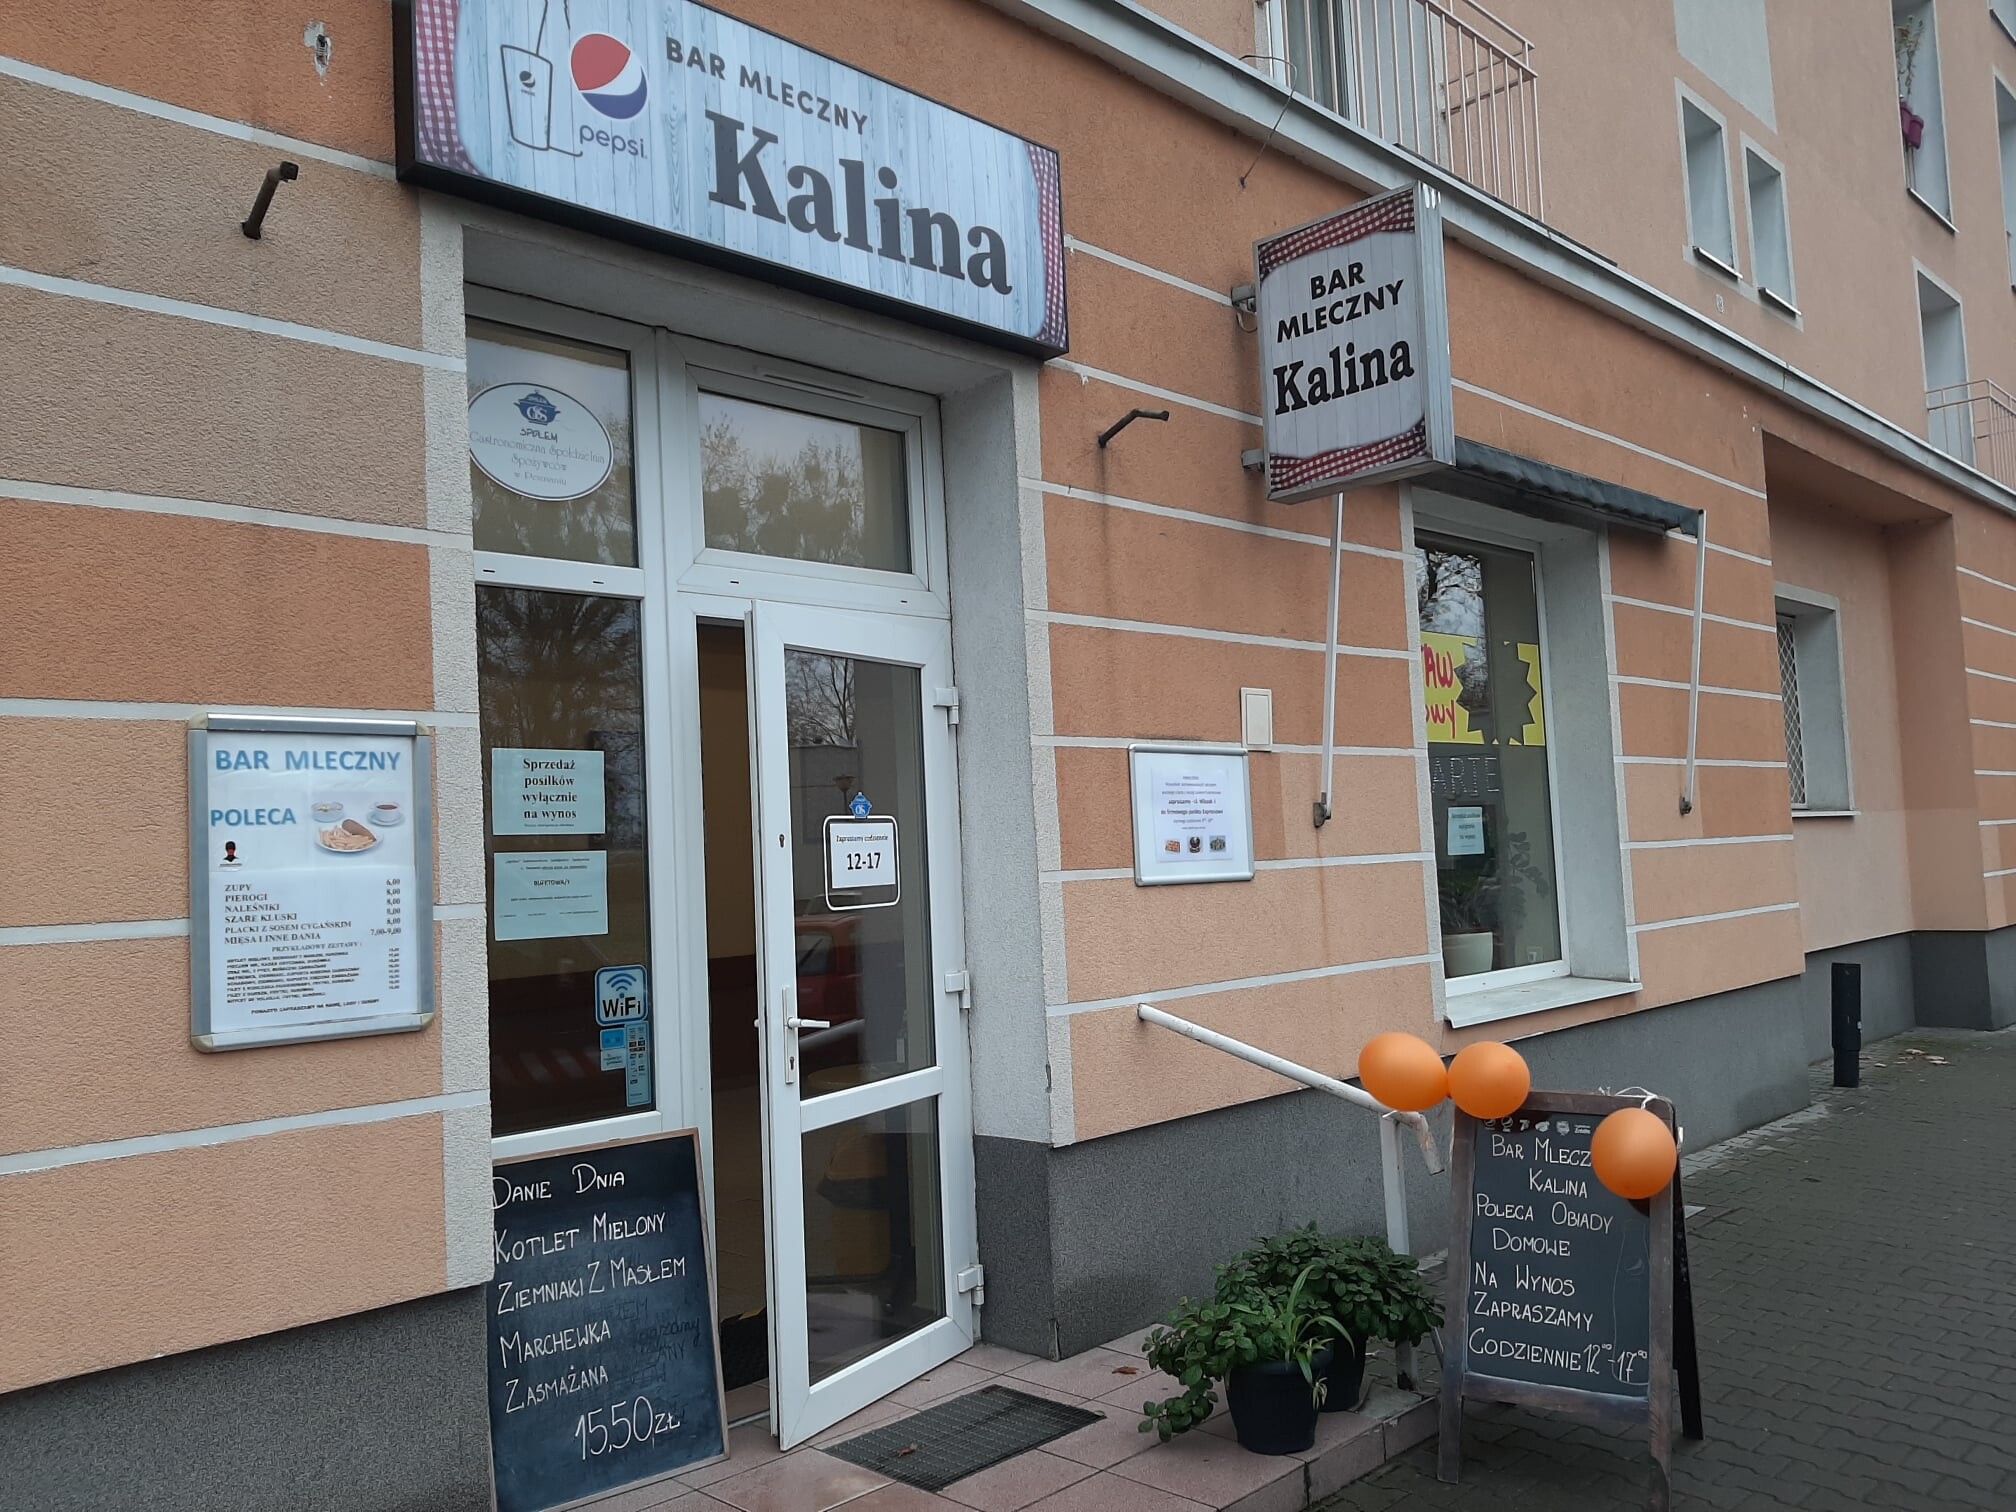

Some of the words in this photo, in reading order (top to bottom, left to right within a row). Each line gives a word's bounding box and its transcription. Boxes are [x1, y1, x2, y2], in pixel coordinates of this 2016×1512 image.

[666, 37, 726, 81] BAR
[739, 63, 868, 136] MLECZNY
[579, 124, 645, 158] pepsi
[704, 108, 1011, 296] Kalina
[1310, 261, 1365, 300] BAR
[1277, 279, 1404, 344] MLECZNY
[1273, 340, 1415, 415] Kalina
[1421, 643, 1454, 689] AW
[215, 750, 270, 771] BAR
[285, 750, 401, 771] MLECZNY
[523, 758, 576, 772] Sprzedaż
[522, 791, 578, 805] wyłącznie
[210, 808, 297, 827] POLECA
[524, 810, 538, 819] na
[541, 809, 577, 821] wynos
[847, 852, 881, 871] 12-17
[224, 883, 252, 892] ZUPY
[225, 893, 267, 902] PIEROGI
[225, 902, 280, 913] NALEŚNIKI
[225, 915, 257, 923] SZARE
[260, 913, 297, 922] KLUSKI
[225, 925, 259, 934] PLACKI
[269, 924, 298, 932] SOSEM
[291, 932, 321, 941] DANIA
[602, 996, 641, 1018] WiFi
[1535, 1137, 1592, 1167] MLECZ
